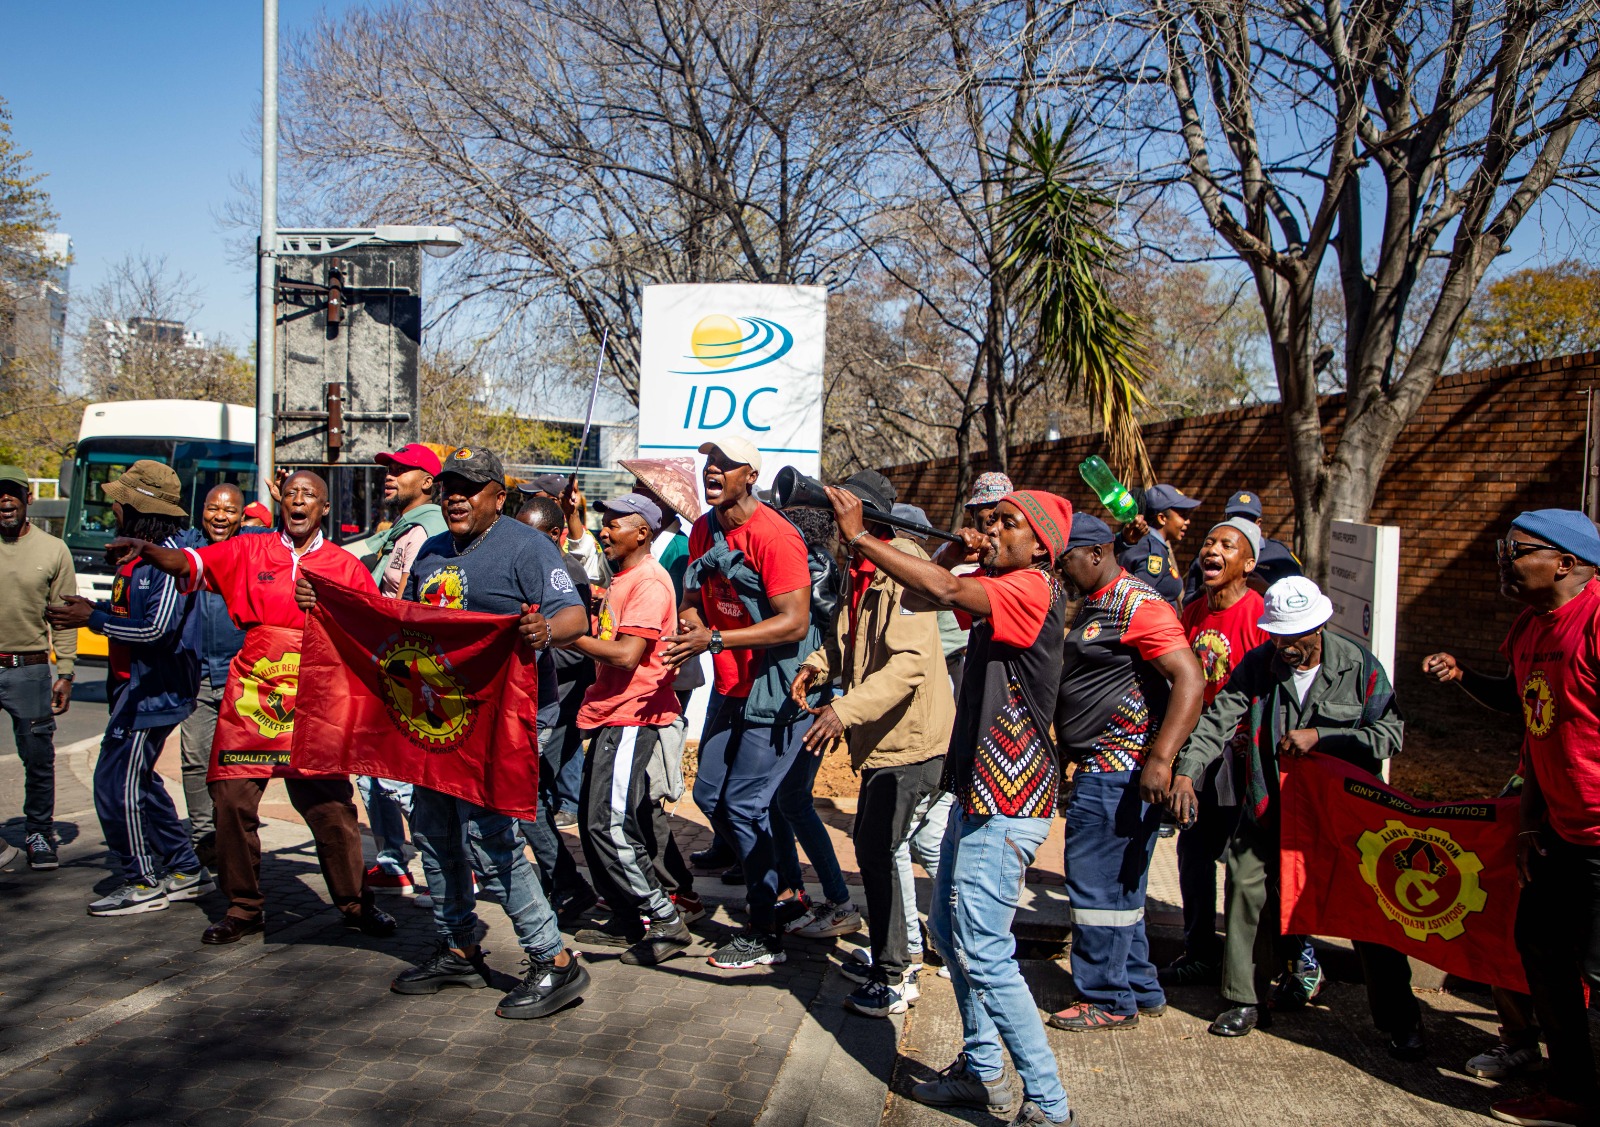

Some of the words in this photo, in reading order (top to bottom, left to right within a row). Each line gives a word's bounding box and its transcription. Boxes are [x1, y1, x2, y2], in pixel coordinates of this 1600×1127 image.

[683, 385, 779, 432] IDC
[409, 736, 429, 752] METAL
[430, 745, 458, 754] WORKERS
[223, 754, 271, 763] EQUALITY
[1350, 784, 1381, 800] LAND!
[1429, 806, 1487, 816] EQUALITY
[1381, 829, 1409, 843] PARTY
[1428, 902, 1466, 930] SOCIALIST
